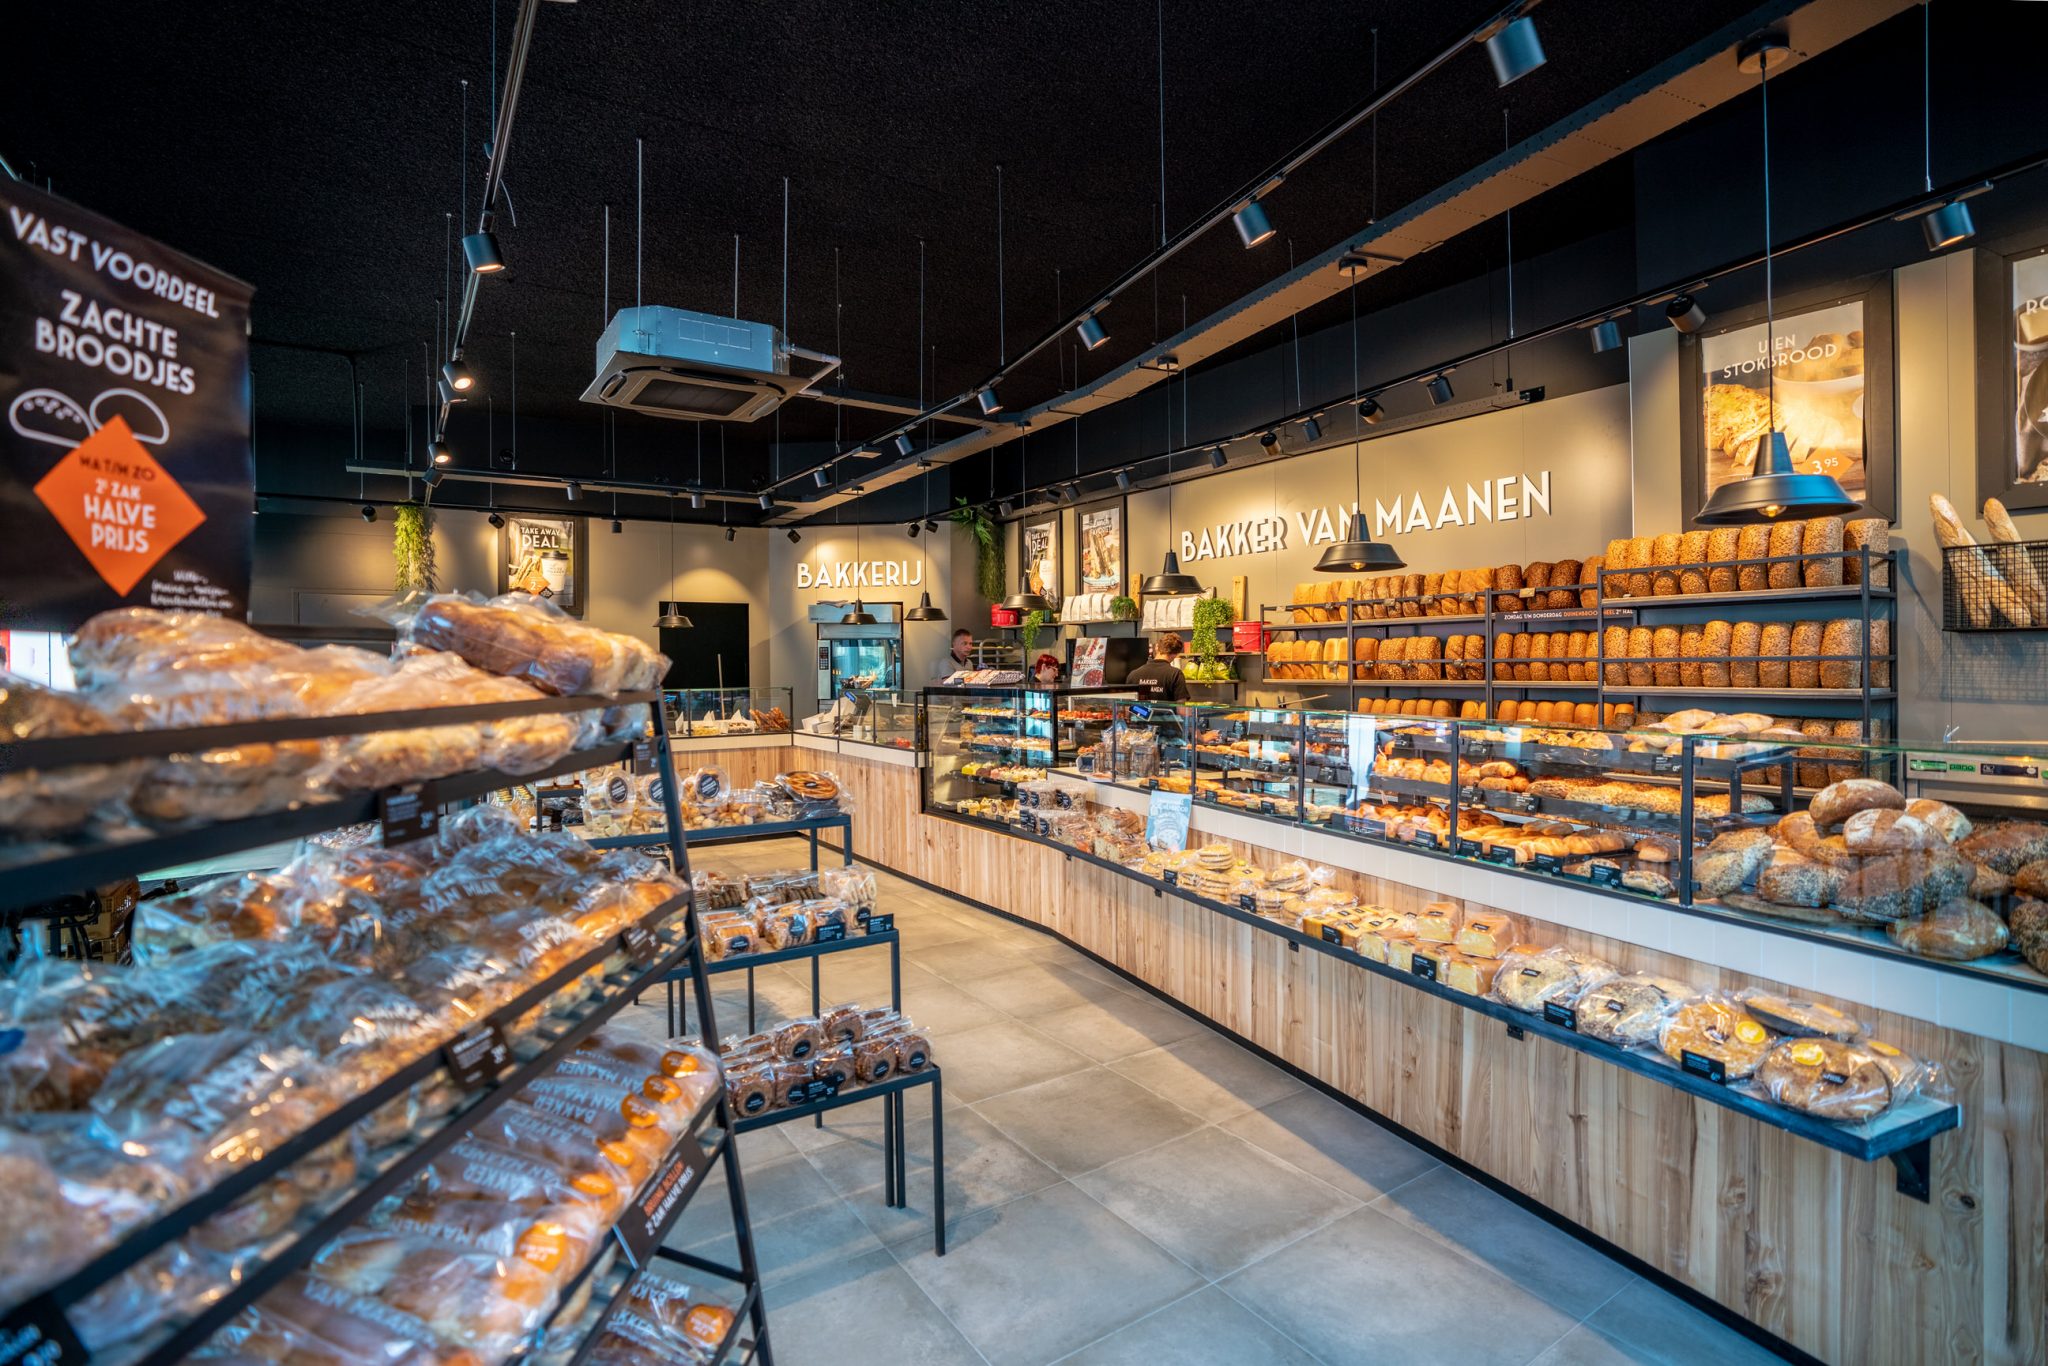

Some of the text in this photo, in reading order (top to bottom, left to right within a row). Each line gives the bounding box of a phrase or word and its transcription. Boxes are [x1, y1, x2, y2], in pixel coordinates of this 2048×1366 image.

[10, 206, 220, 319] VAST VOORDEEL
[60, 290, 178, 360] ZACHTE
[35, 317, 196, 395] BROODJES
[1723, 343, 1838, 379] STOKBROOD
[110, 480, 142, 501] ZAK
[132, 468, 156, 482] ZO
[84, 493, 157, 529] HALVE
[1181, 470, 1551, 563] BAKKER VAN MAANEN
[91, 523, 150, 554] PRIJS
[520, 527, 561, 536] TAKE AWAY
[521, 534, 560, 548] DEAL
[797, 560, 923, 588] BAKKERIJ
